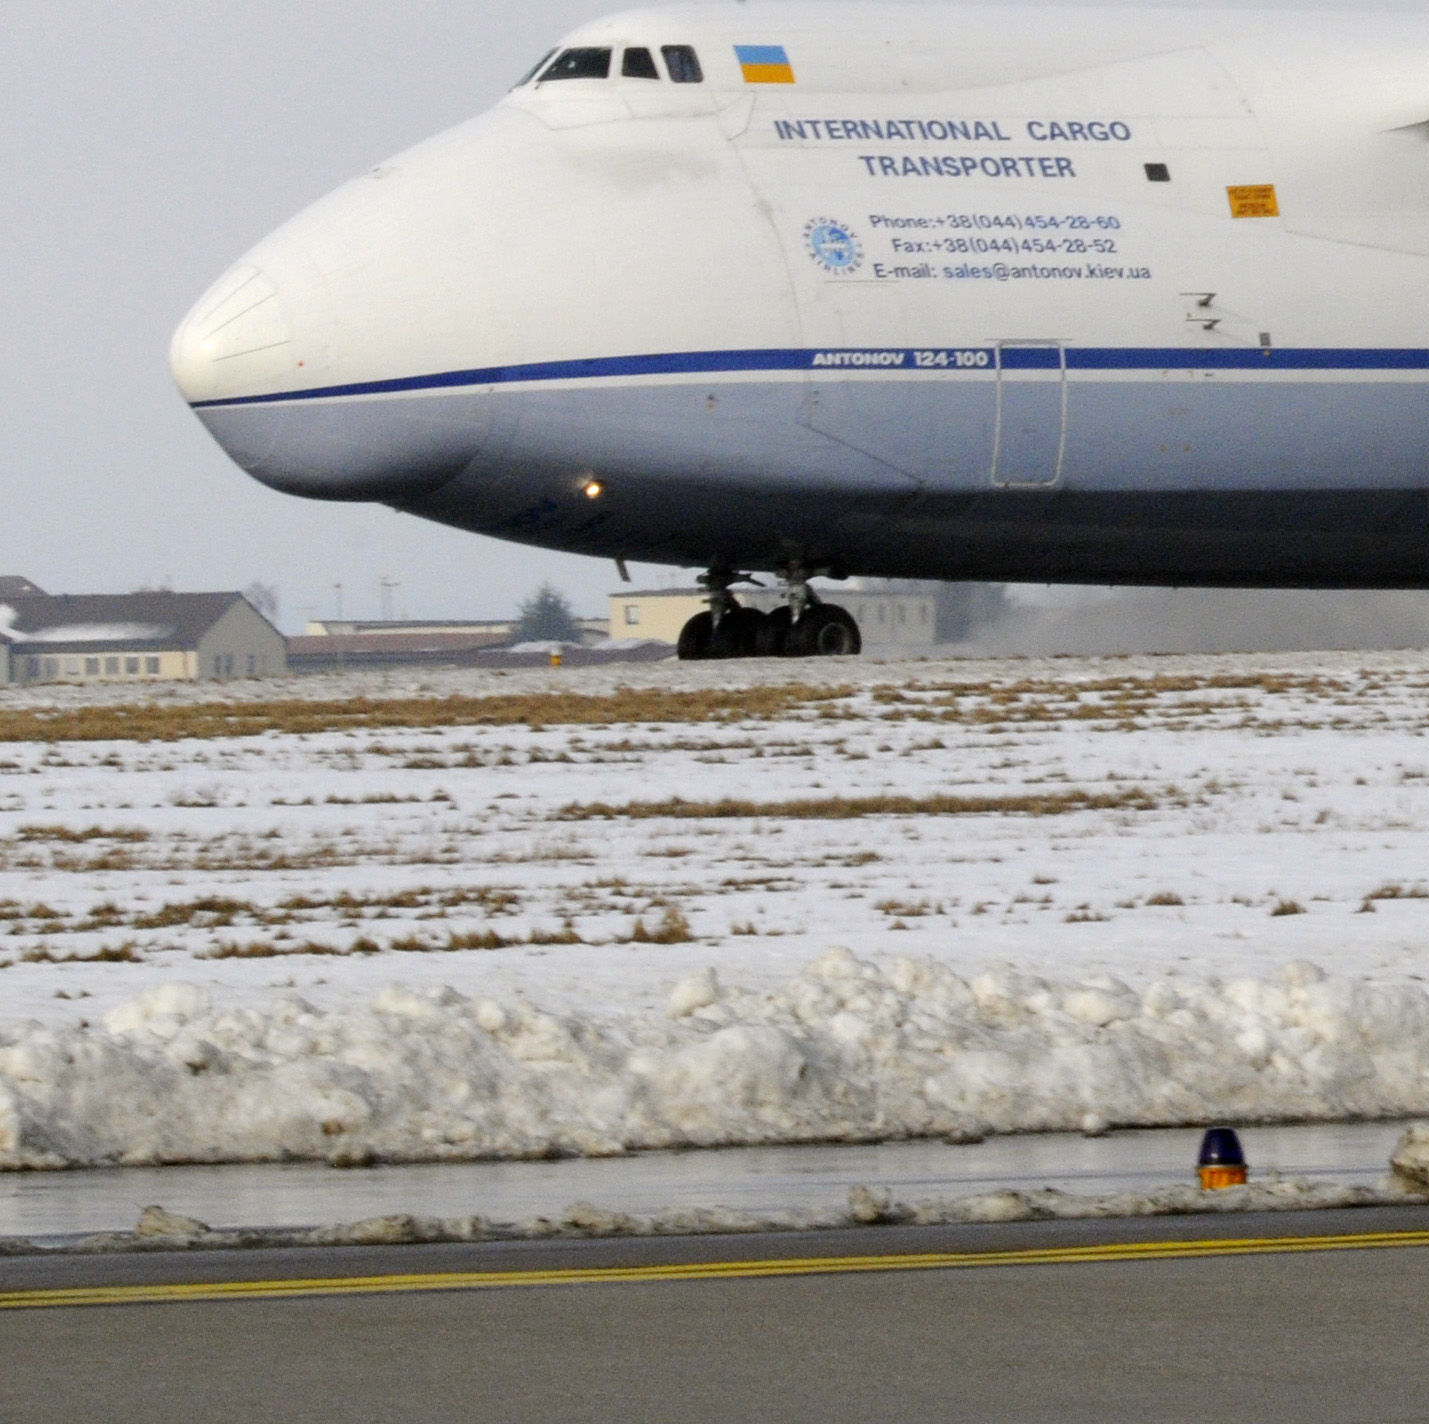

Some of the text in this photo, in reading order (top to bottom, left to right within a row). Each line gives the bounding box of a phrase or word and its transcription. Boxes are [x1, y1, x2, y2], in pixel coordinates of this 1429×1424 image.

[773, 119, 1131, 142] INTERNATIONAL CARGO
[858, 155, 1076, 178] TRANSPORTER
[873, 263, 1152, 282] E-mail: sales@antonov.kiev.ua
[812, 351, 989, 367] ANTONOV 124-100
